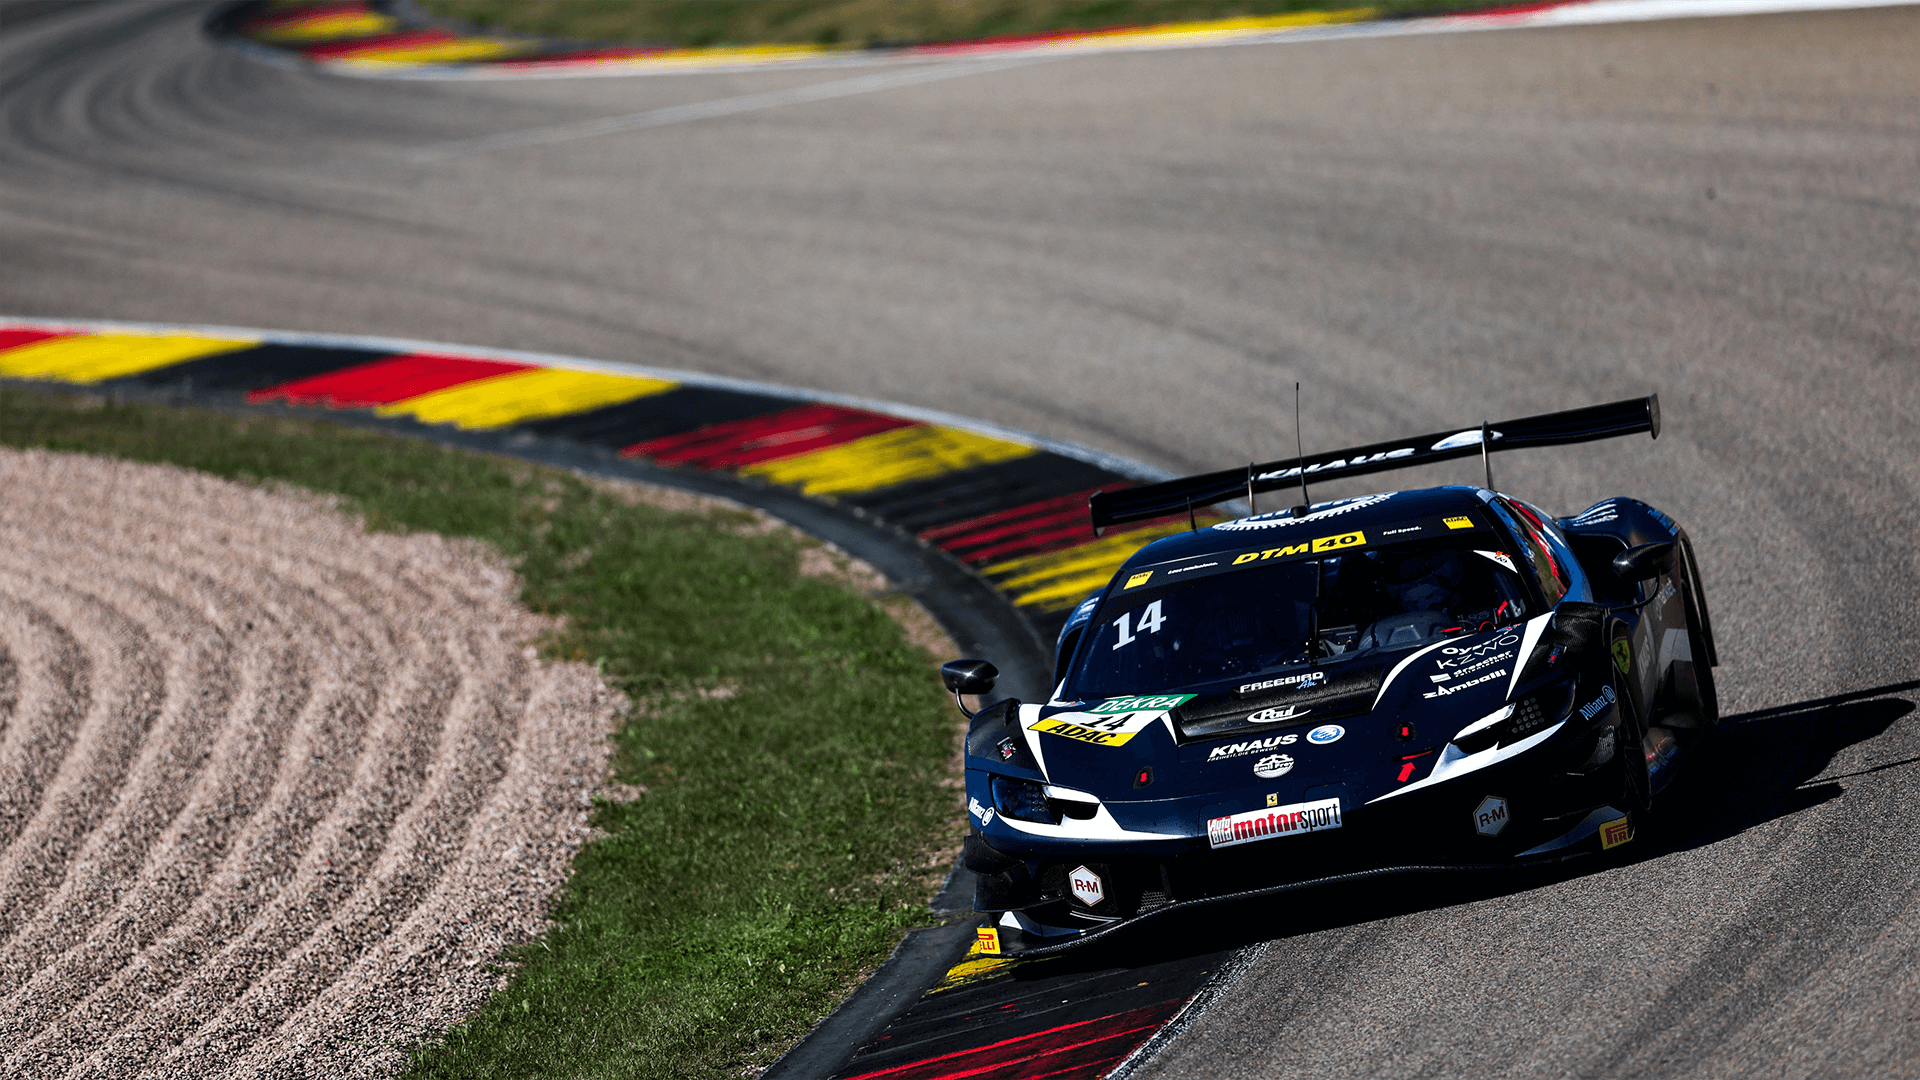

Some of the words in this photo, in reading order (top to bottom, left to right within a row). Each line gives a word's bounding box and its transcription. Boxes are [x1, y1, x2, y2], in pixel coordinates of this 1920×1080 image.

[1232, 543, 1309, 565] DTM
[1319, 536, 1358, 548] 40
[1112, 599, 1167, 651] 14
[1240, 671, 1324, 693] FREEBIRD
[1090, 696, 1184, 712] DEKRA
[1579, 695, 1608, 721] Allianz
[1080, 713, 1136, 731] 14
[1046, 723, 1117, 744] ADAC
[1209, 733, 1298, 758] KNAUS
[1479, 806, 1506, 827] R-M
[1074, 878, 1100, 894] R-M
